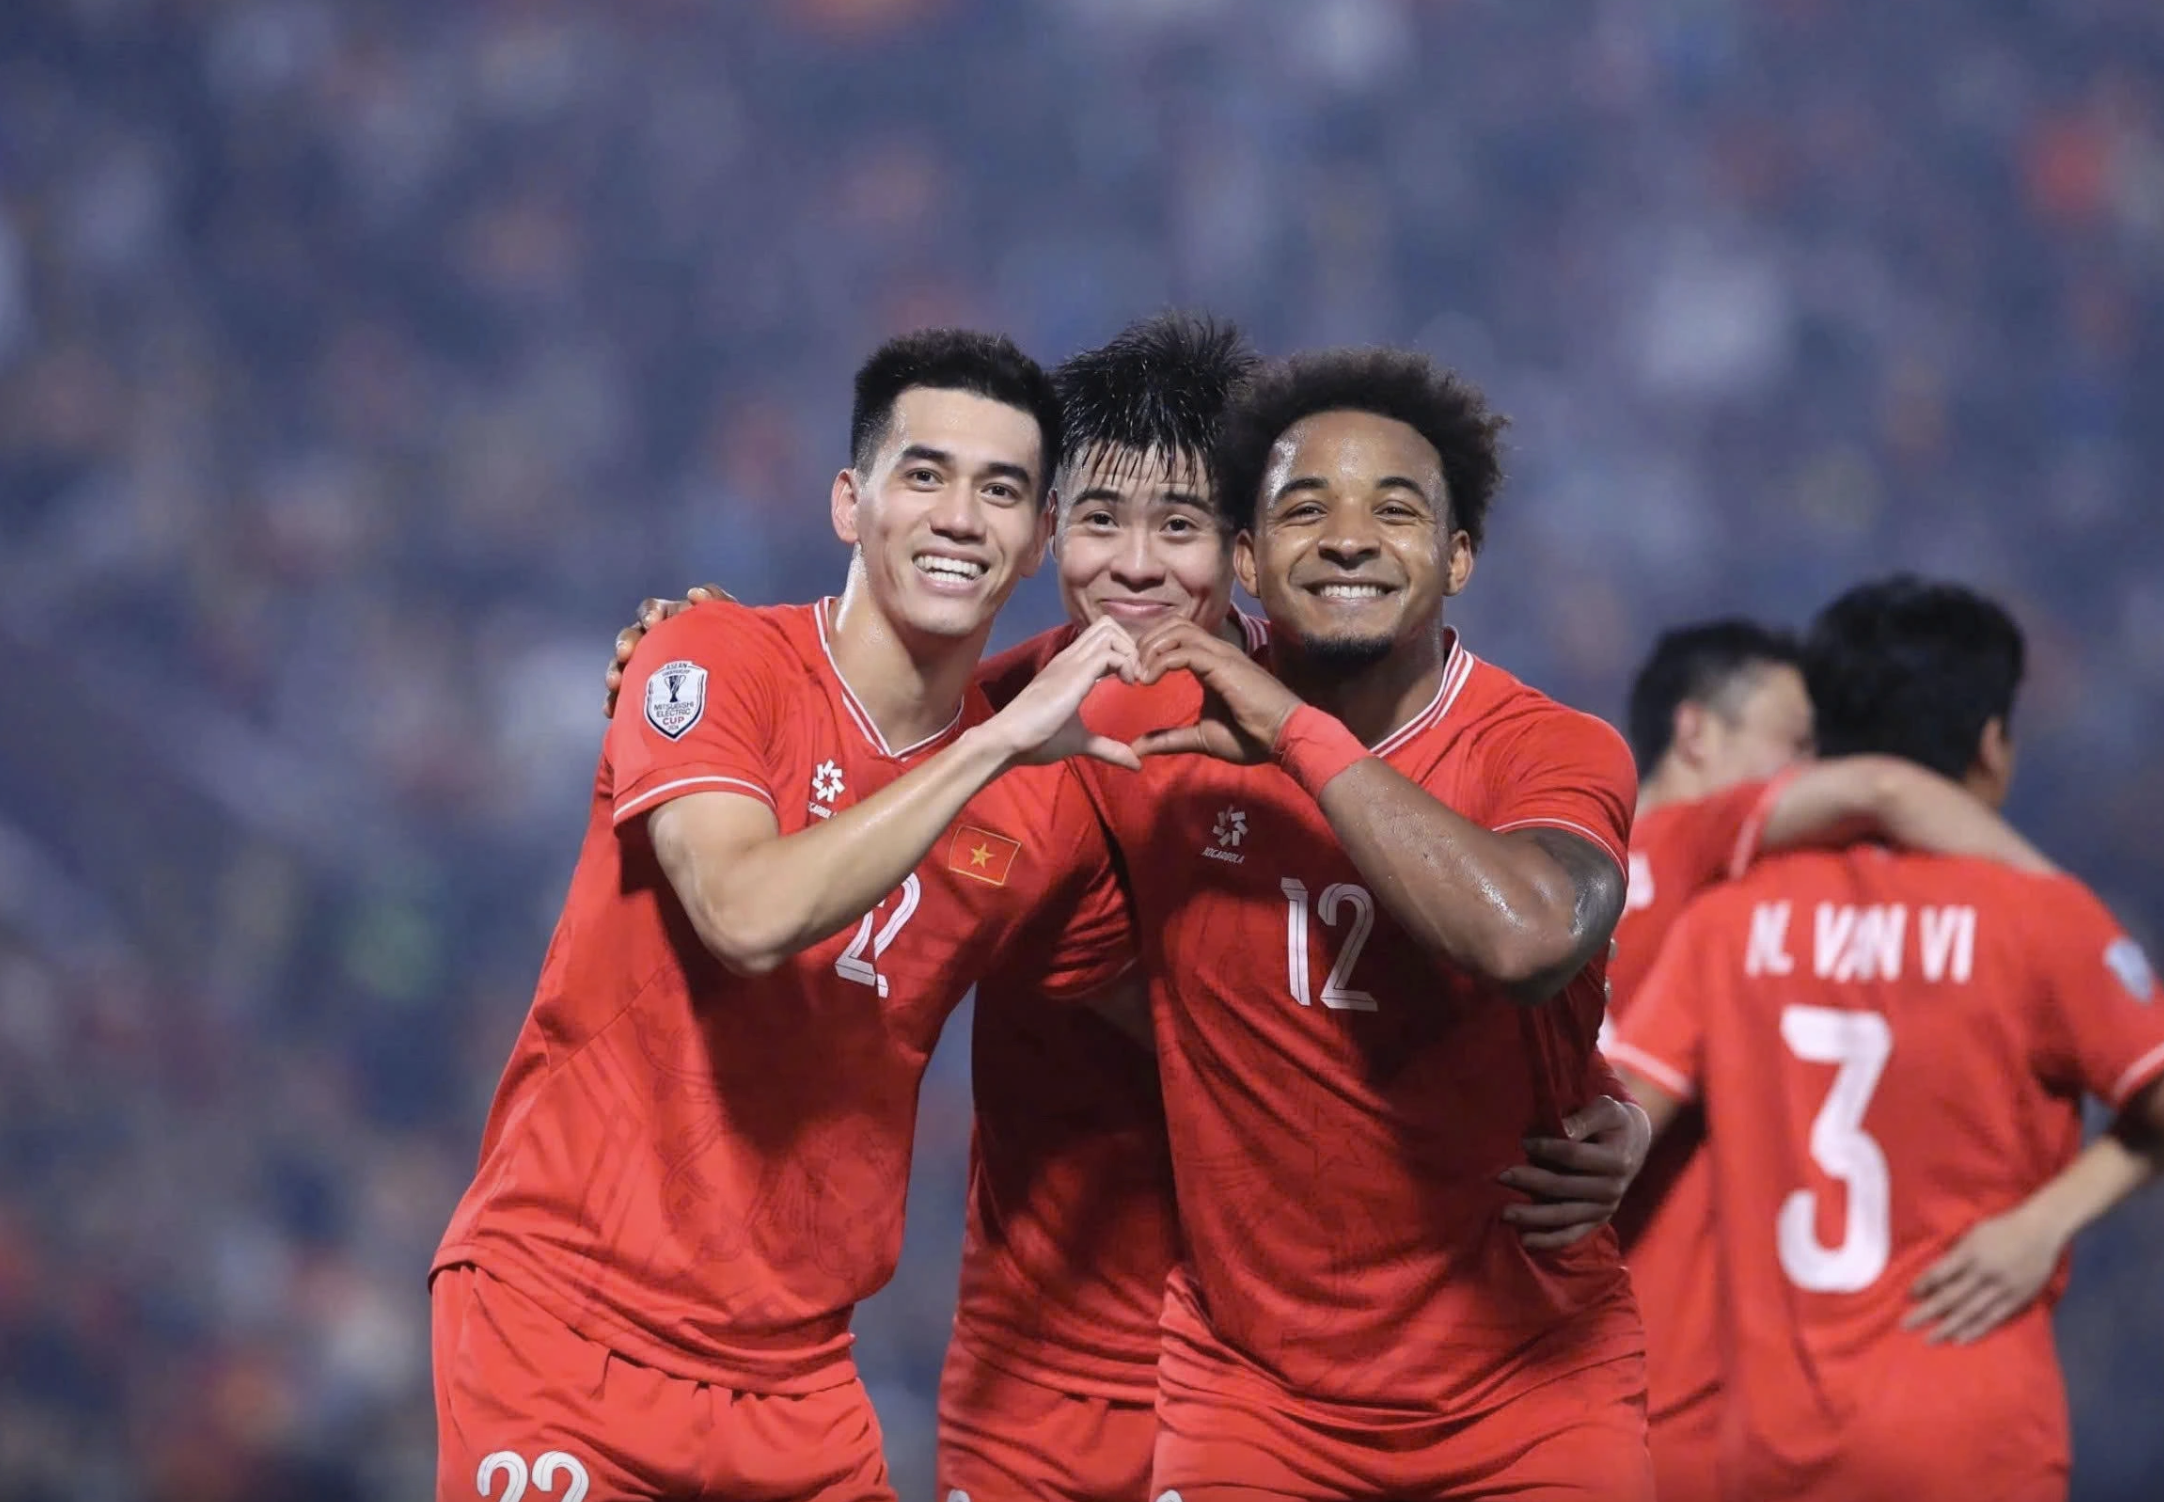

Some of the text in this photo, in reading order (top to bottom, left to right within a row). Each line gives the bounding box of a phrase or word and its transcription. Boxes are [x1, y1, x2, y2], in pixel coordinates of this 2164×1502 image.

[654, 701, 694, 711] MITSUBISHI
[656, 708, 691, 718] ELECTRIC
[662, 716, 685, 726] CUP
[1280, 877, 1379, 1012] 12
[1814, 901, 1907, 983] VAN
[1920, 904, 1977, 984] VI
[1776, 1004, 1892, 1292] 3
